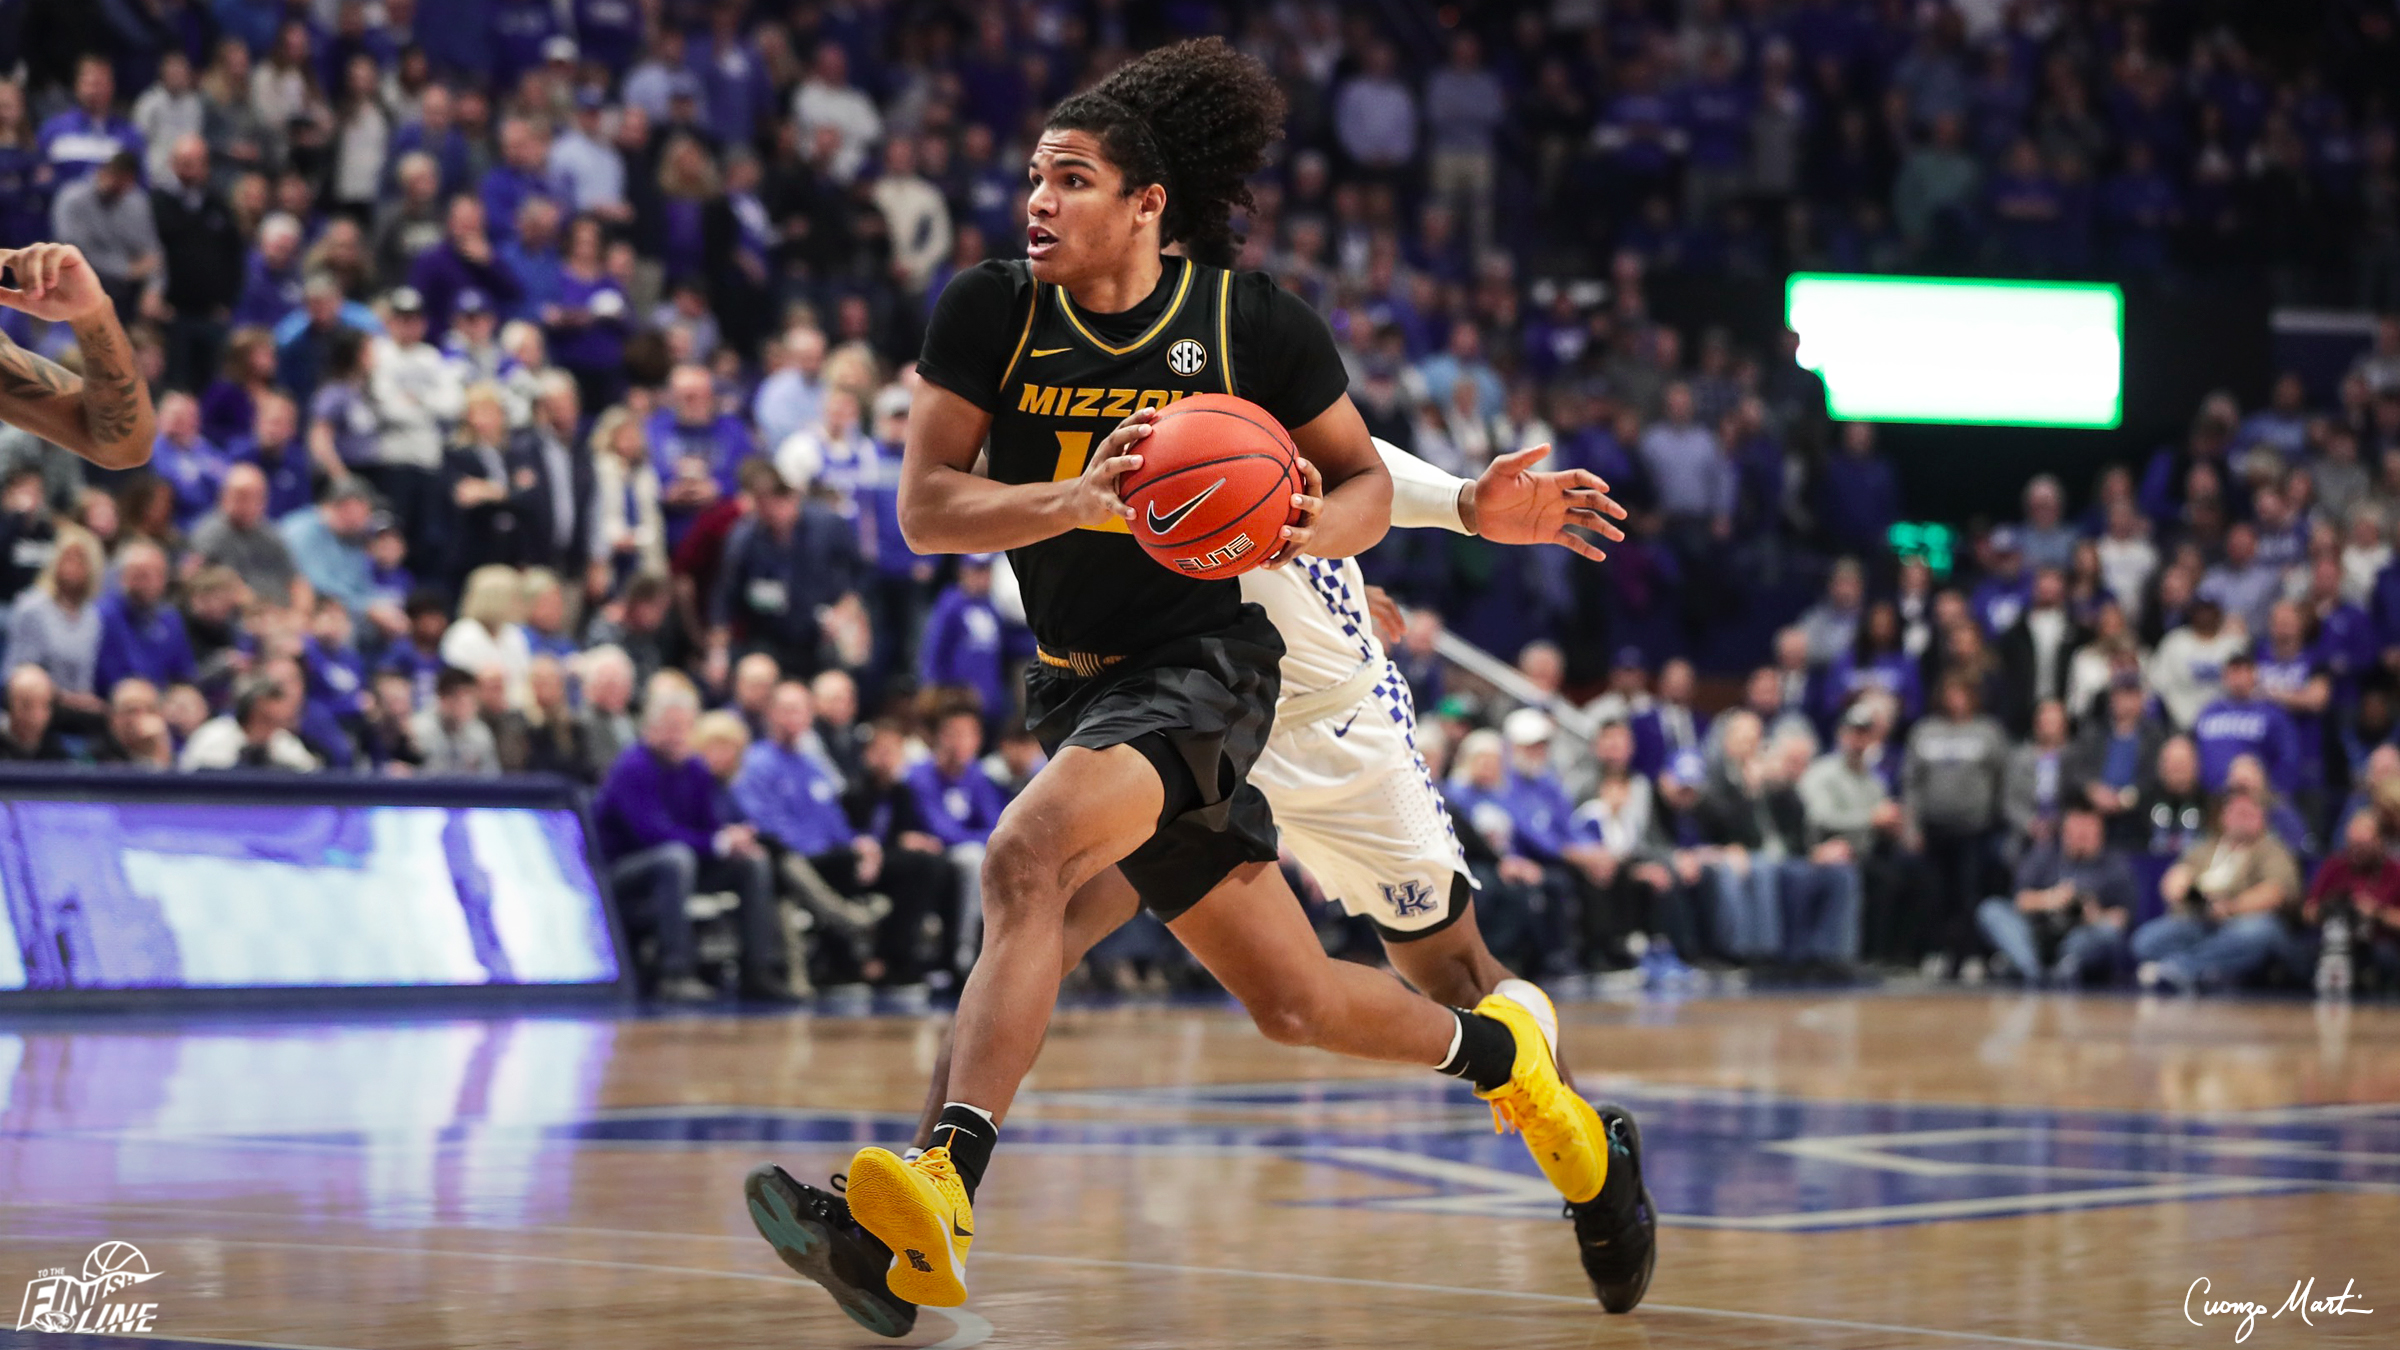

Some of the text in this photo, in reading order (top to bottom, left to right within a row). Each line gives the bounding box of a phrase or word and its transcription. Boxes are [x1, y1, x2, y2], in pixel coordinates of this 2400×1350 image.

[1170, 341, 1203, 374] SEC
[1017, 383, 1203, 417] MIZZO
[1173, 532, 1255, 571] ELITE
[1378, 879, 1438, 918] UK
